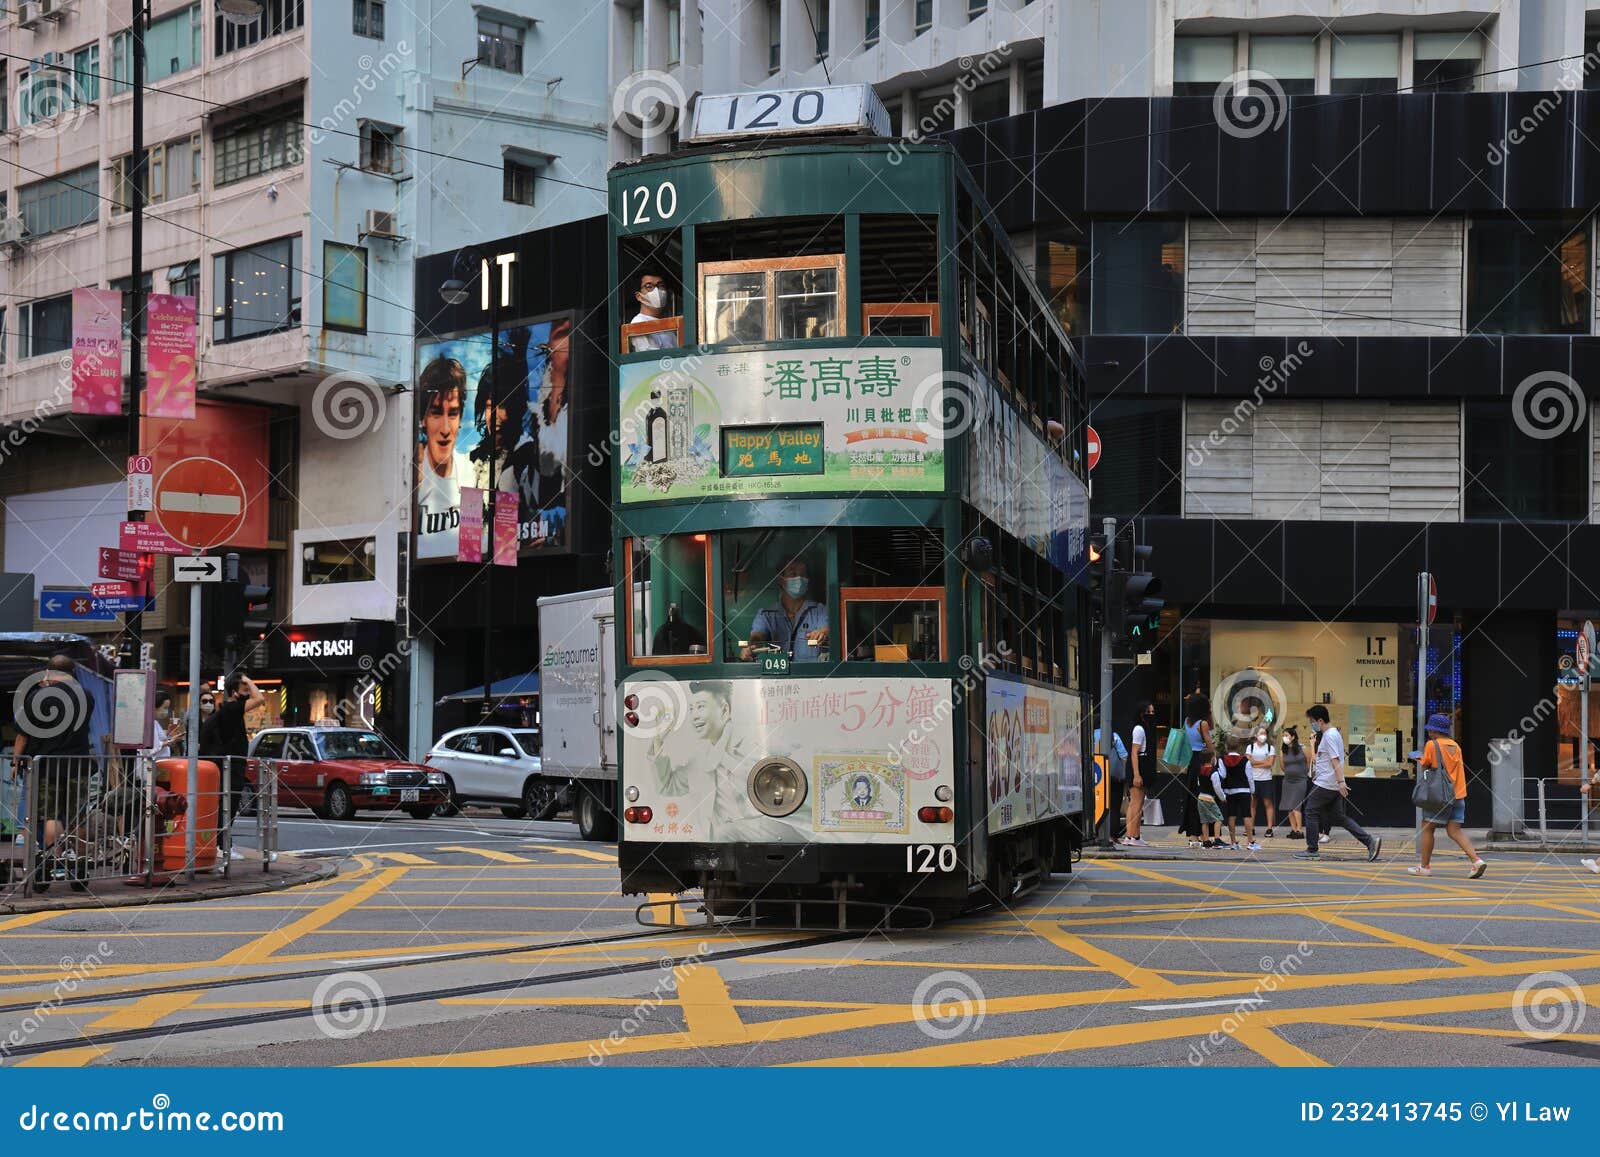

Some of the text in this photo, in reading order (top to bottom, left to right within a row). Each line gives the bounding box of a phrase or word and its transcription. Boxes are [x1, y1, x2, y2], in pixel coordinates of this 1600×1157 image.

[727, 90, 825, 131] 120
[622, 181, 677, 227] 120
[727, 431, 820, 449] Happy Valley
[737, 450, 813, 468] 跑馬地
[290, 639, 353, 658] MEN'S BASH
[765, 658, 787, 670] 049
[906, 844, 958, 873] 120
